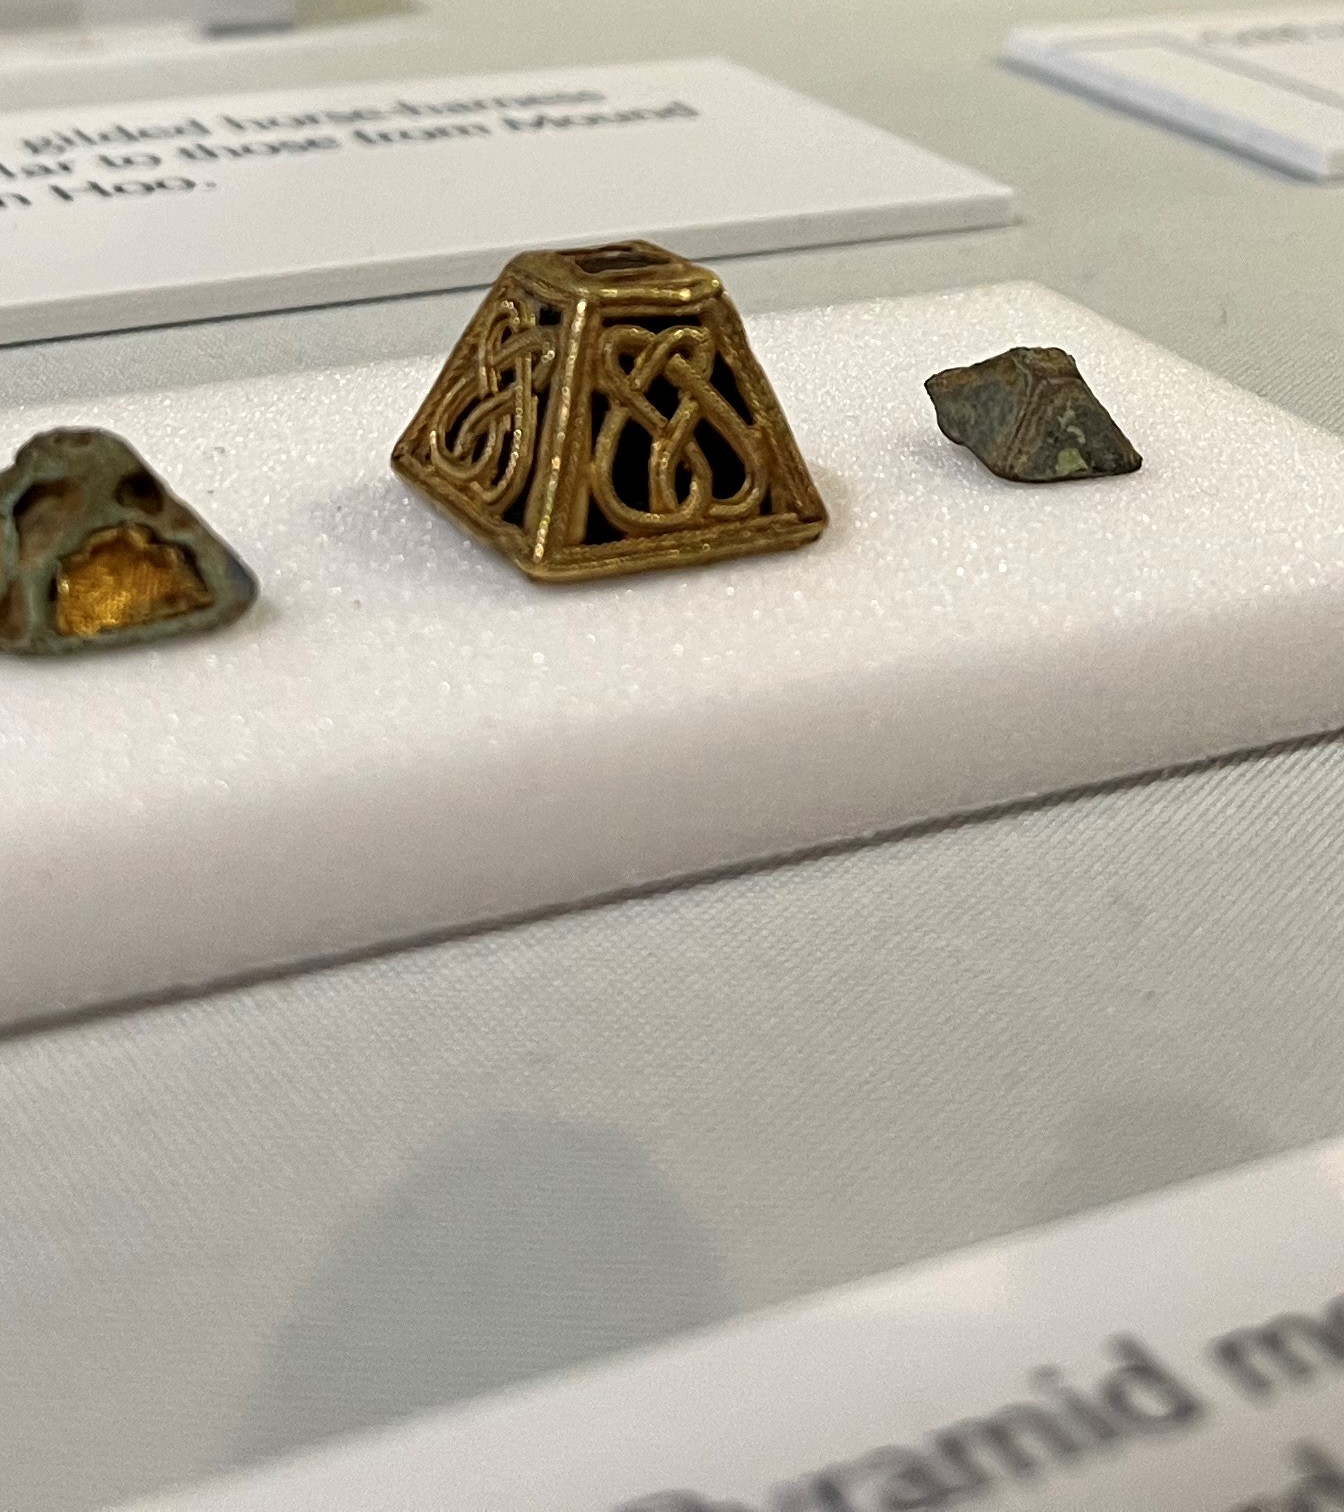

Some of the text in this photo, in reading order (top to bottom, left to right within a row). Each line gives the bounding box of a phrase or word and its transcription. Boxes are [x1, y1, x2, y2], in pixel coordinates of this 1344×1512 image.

[21, 116, 212, 158] gilded
[98, 150, 164, 173] to
[177, 134, 343, 166] those
[353, 115, 494, 148] from
[500, 98, 701, 136] Mound
[47, 175, 218, 204] Hoo.
[611, 1330, 1206, 1512] ramid
